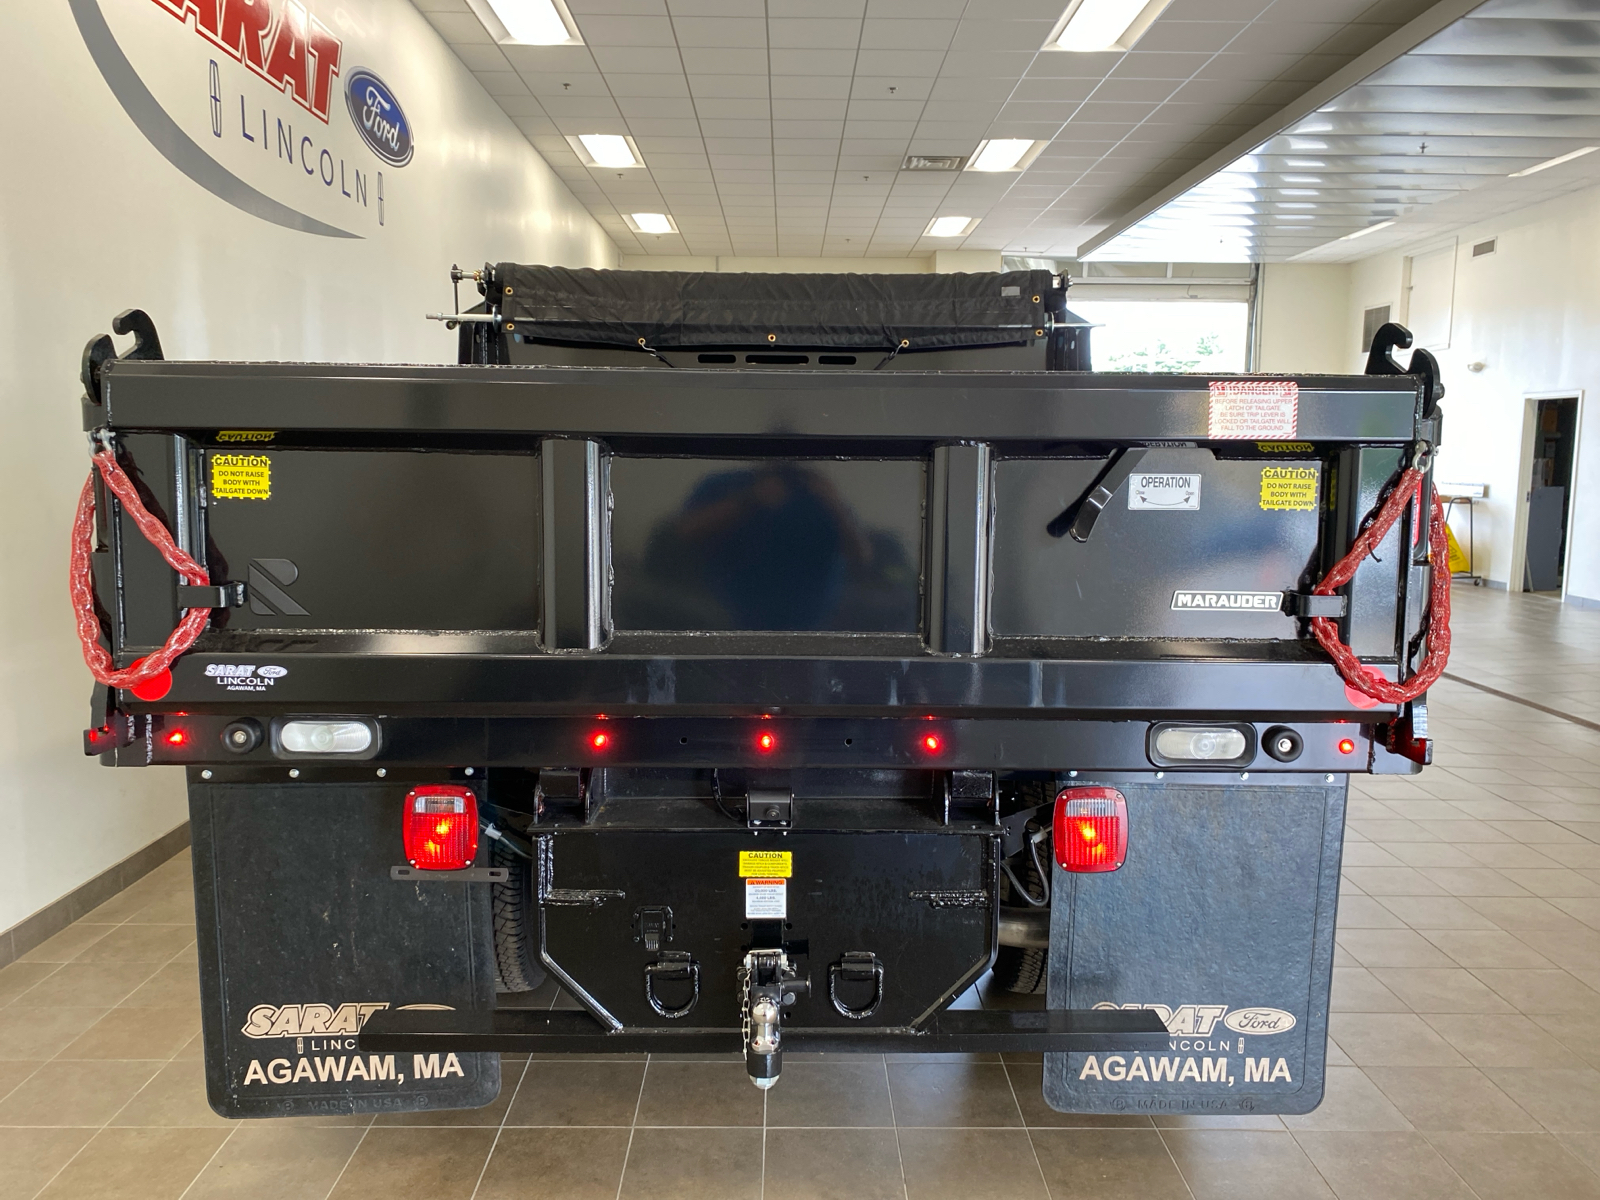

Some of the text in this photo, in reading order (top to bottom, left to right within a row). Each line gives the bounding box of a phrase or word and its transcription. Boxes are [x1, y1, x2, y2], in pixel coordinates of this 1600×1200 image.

[363, 85, 400, 152] Ford
[241, 94, 367, 207] LINCOLN
[214, 457, 268, 467] CAUTION
[1264, 470, 1316, 479] CAUTION
[1140, 476, 1191, 488] OPERATION
[1177, 594, 1277, 609] MARAUDER
[204, 664, 256, 678] SARAT
[216, 676, 274, 686] LINCOLN
[241, 1002, 390, 1039] SARAT
[1238, 1012, 1280, 1030] Ford
[312, 1039, 356, 1051] LINC
[1168, 1040, 1230, 1051] NCOLN
[243, 1052, 464, 1086] AGAWAM, MA
[1079, 1055, 1292, 1086] AGAWAM, MA
[308, 1099, 348, 1110] MADE
[352, 1098, 368, 1108] IN
[373, 1098, 403, 1109] USA
[1137, 1098, 1176, 1110] MADE
[1181, 1098, 1196, 1110] IN
[1200, 1098, 1228, 1110] USA
